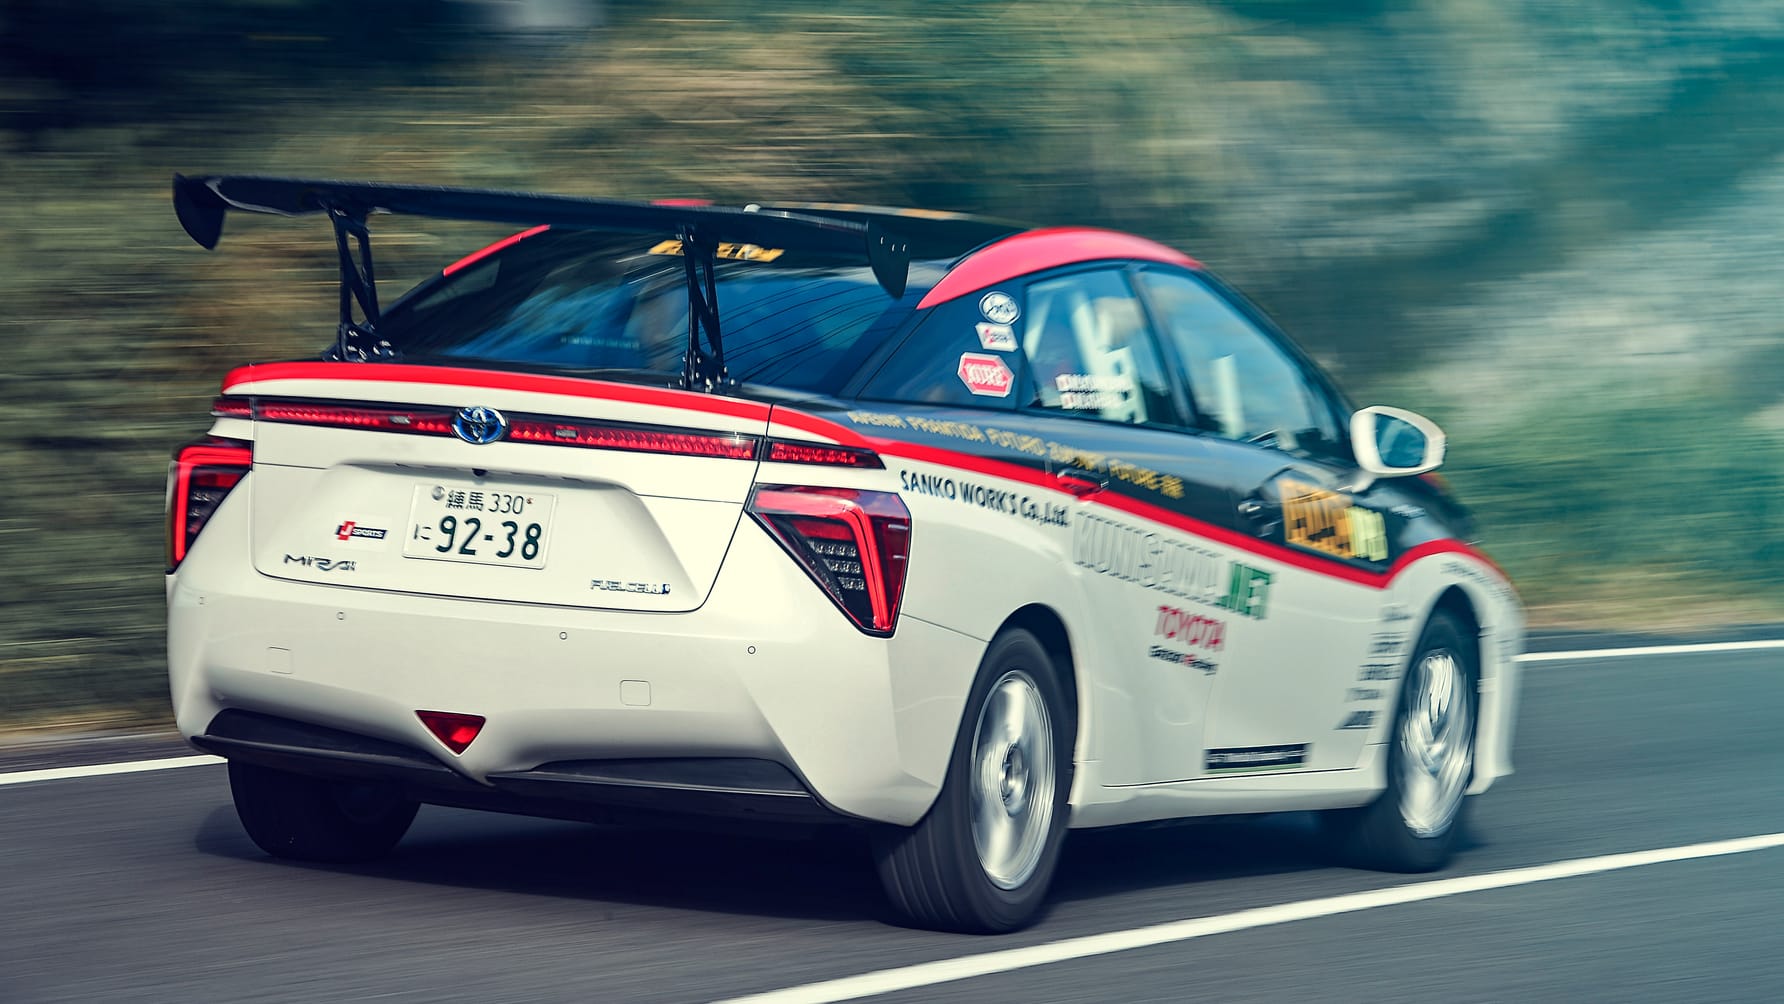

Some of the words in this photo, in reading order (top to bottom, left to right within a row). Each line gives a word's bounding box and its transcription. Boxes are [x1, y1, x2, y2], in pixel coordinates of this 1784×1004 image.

[900, 469, 956, 500] SANKO
[488, 493, 524, 515] 330
[413, 523, 432, 541] に
[435, 515, 542, 561] 92-38
[283, 553, 357, 572] MIRAI
[1154, 605, 1227, 652] TOYOTA
